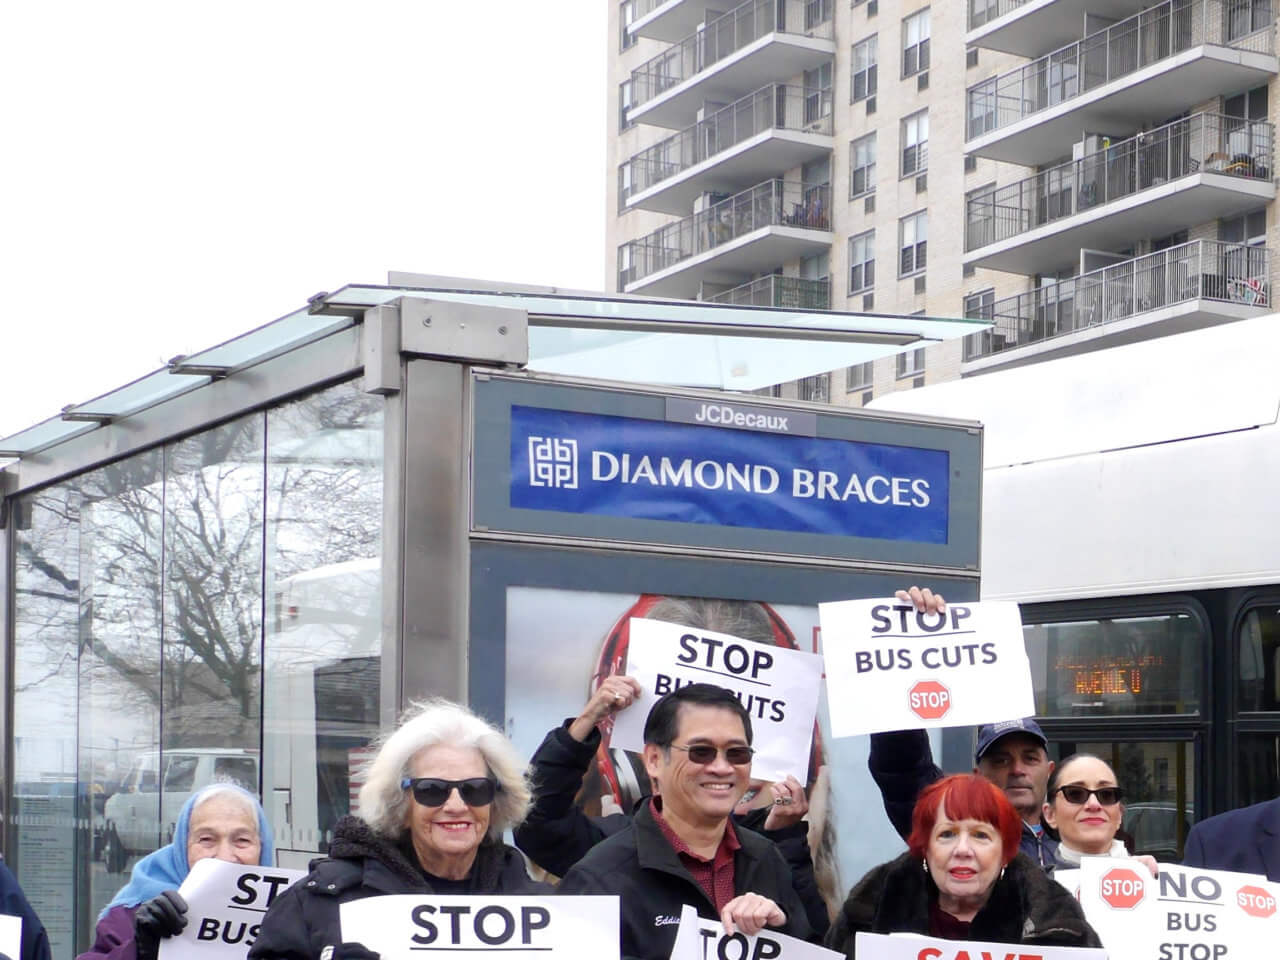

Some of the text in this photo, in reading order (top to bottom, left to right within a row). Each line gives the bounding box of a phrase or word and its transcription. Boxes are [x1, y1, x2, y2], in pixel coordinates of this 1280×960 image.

[696, 404, 789, 430] JCDecaux
[591, 450, 930, 508] DIAMOND BRACES
[871, 605, 971, 633] STOP
[677, 634, 774, 679] STOP
[856, 643, 997, 673] BUS CUTS
[725, 688, 786, 722] UTS
[911, 692, 948, 708] STOP
[231, 873, 289, 907] ST
[1102, 871, 1276, 911] STOP NO STOP
[411, 904, 551, 945] STOP
[1167, 912, 1217, 932] BUS
